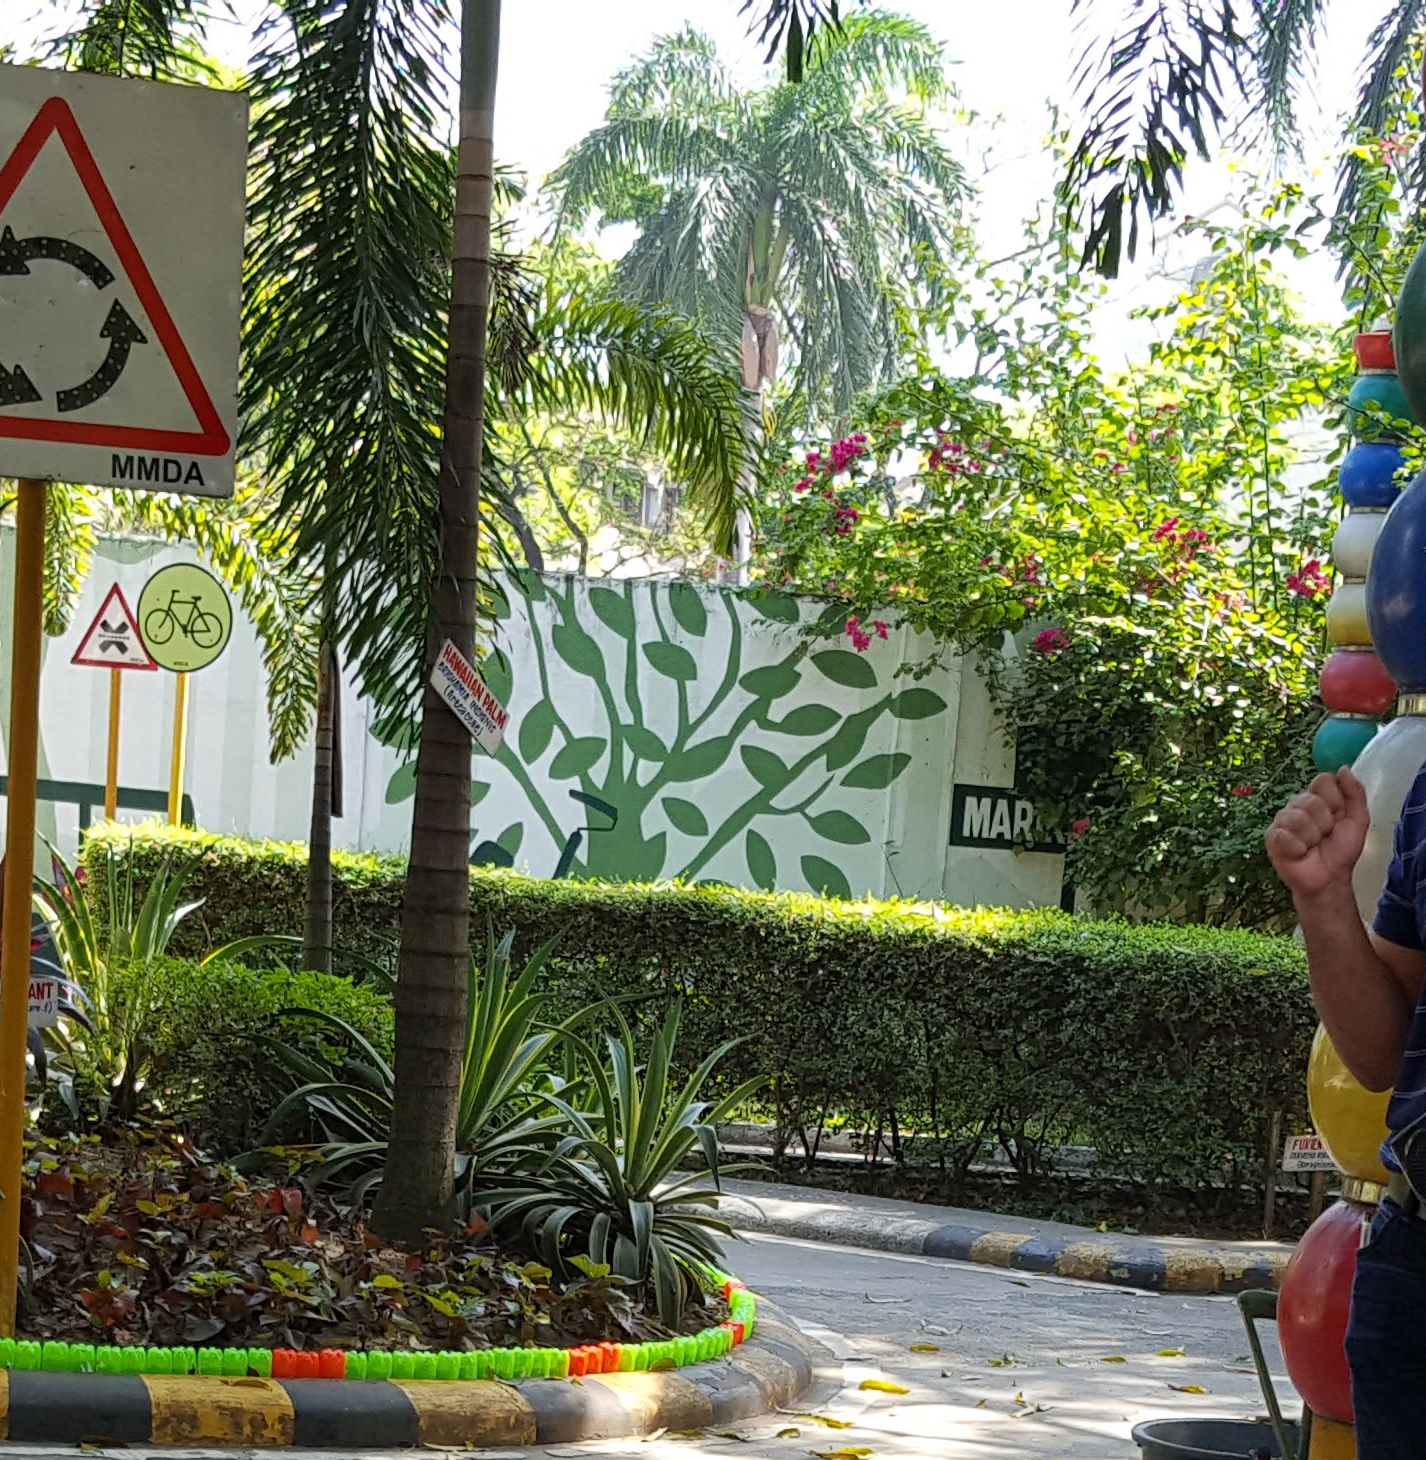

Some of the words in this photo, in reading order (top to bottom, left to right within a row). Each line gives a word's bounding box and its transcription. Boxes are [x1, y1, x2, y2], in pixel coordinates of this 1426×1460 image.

[111, 453, 205, 486] MMDA
[442, 643, 485, 702] HAWAIIAN
[482, 692, 508, 731] PALM
